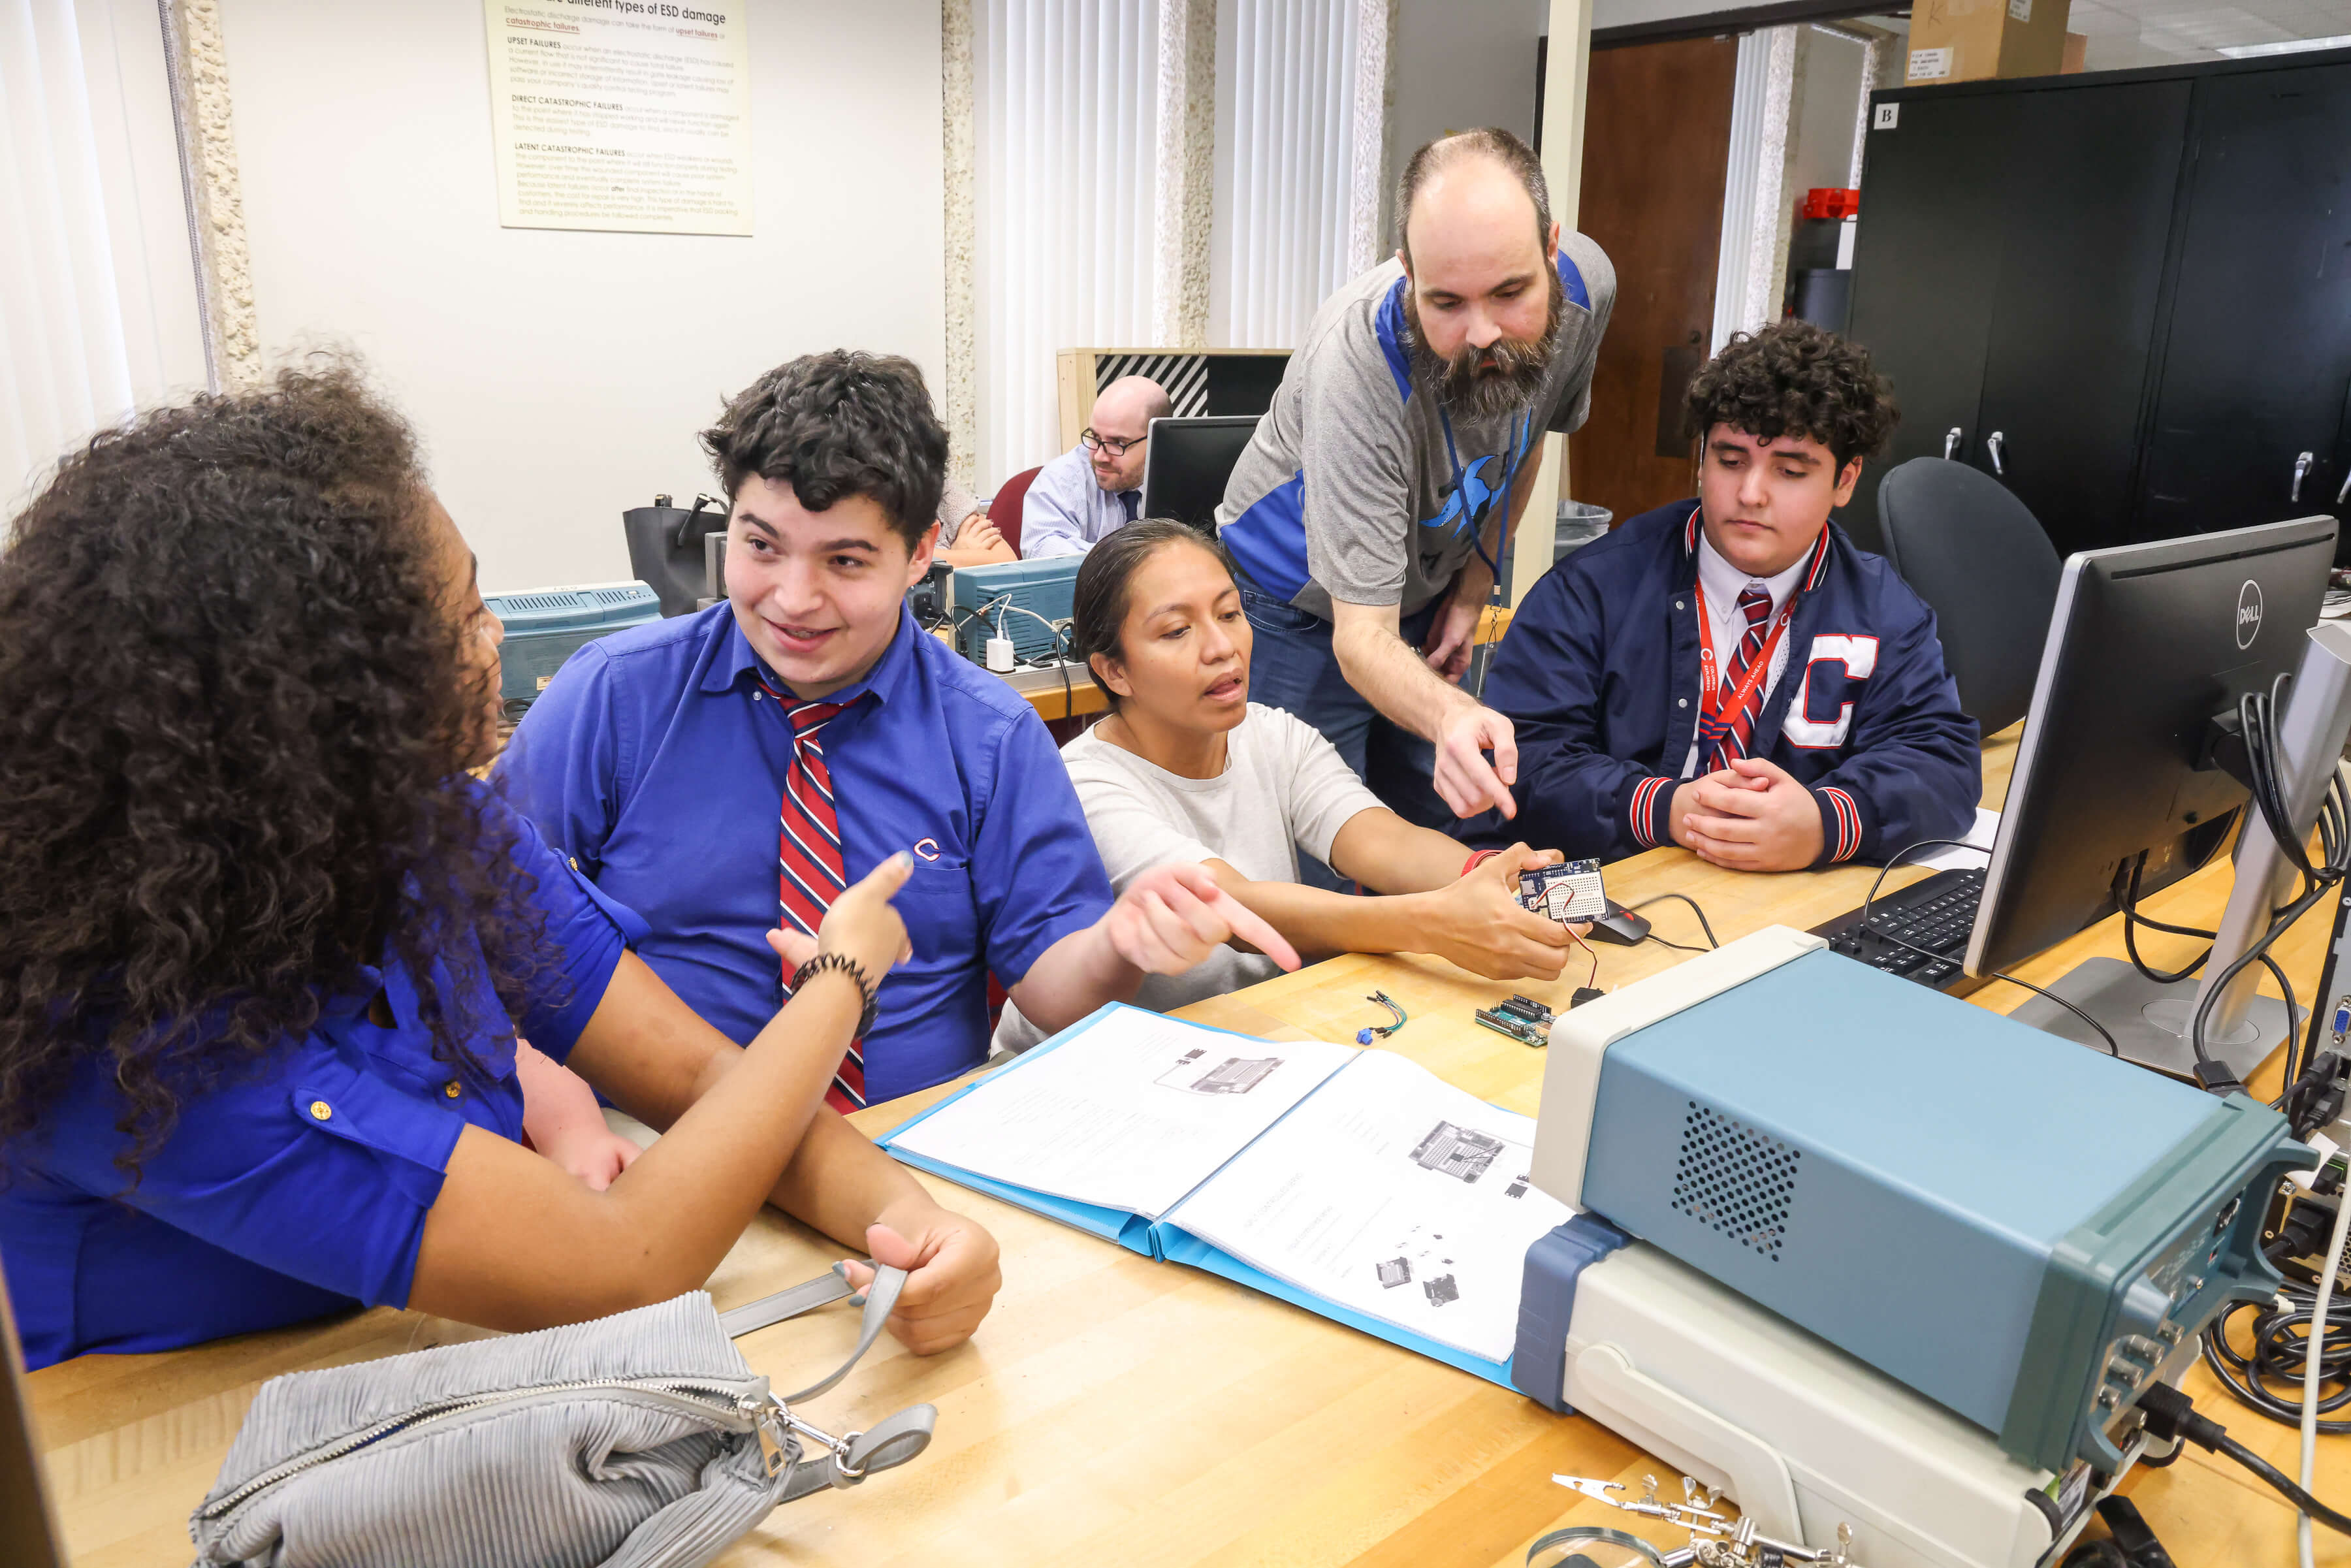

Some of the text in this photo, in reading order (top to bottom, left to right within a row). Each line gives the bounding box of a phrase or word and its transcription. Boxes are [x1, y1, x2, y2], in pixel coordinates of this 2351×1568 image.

[615, 1, 644, 14] types
[648, 3, 657, 14] of
[661, 5, 679, 17] ESD
[682, 8, 726, 25] damage
[505, 17, 551, 28] catastrophic
[694, 28, 718, 37] failures
[507, 36, 527, 45] UPSET
[530, 39, 560, 48] FAILURES
[511, 94, 536, 103] DIRECT
[537, 96, 590, 108] CATASTROPHIC
[593, 101, 622, 110] FAILURES
[1881, 110, 1891, 122] B
[541, 144, 594, 154] CATASTROPHIC
[2239, 605, 2259, 625] DELL
[1701, 648, 1714, 661] C
[1737, 660, 1764, 700] ALWAYS AHEAD
[1781, 634, 1879, 749] C
[913, 837, 941, 862] C
